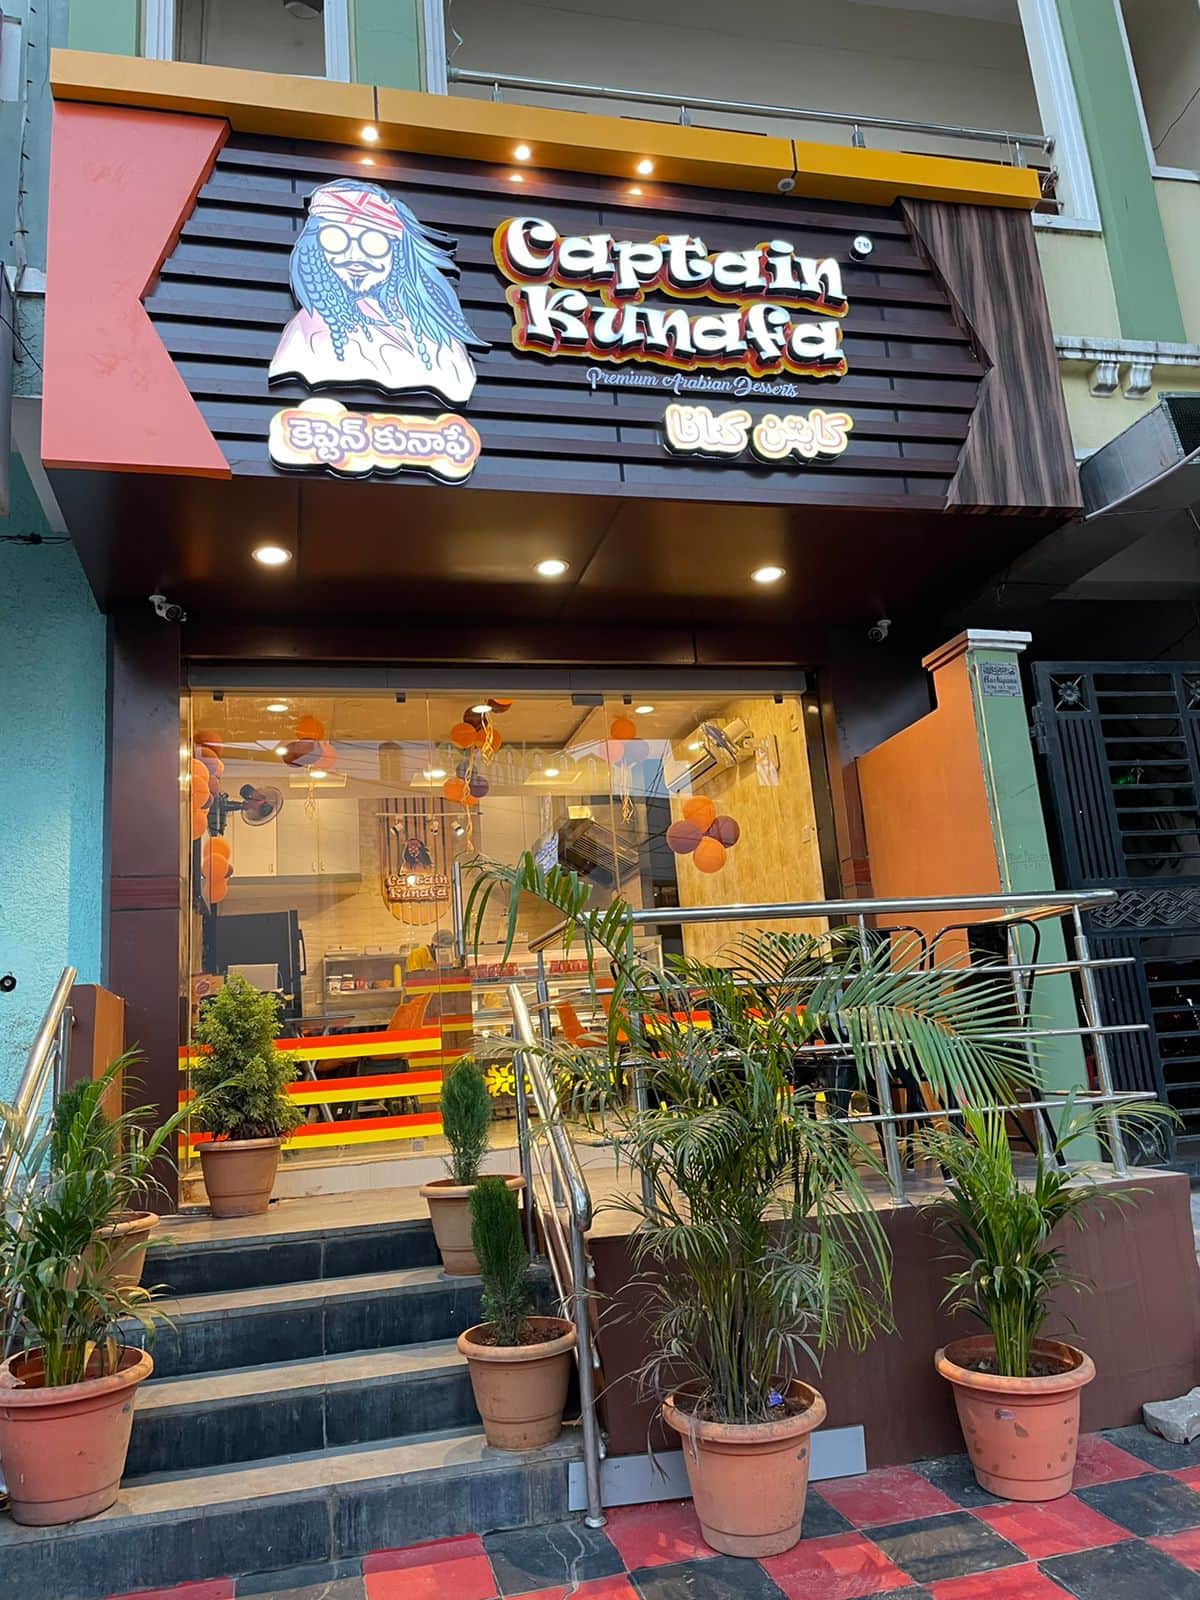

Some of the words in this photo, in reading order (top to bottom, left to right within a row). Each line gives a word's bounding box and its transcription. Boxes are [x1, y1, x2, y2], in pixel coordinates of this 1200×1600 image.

[503, 216, 848, 303] Captain
[517, 285, 846, 362] Kunafa
[586, 367, 657, 389] Premium
[662, 373, 732, 395] Arabian
[733, 376, 799, 398] Desserts
[756, 411, 850, 454] كابتن
[387, 874, 448, 887] Catain
